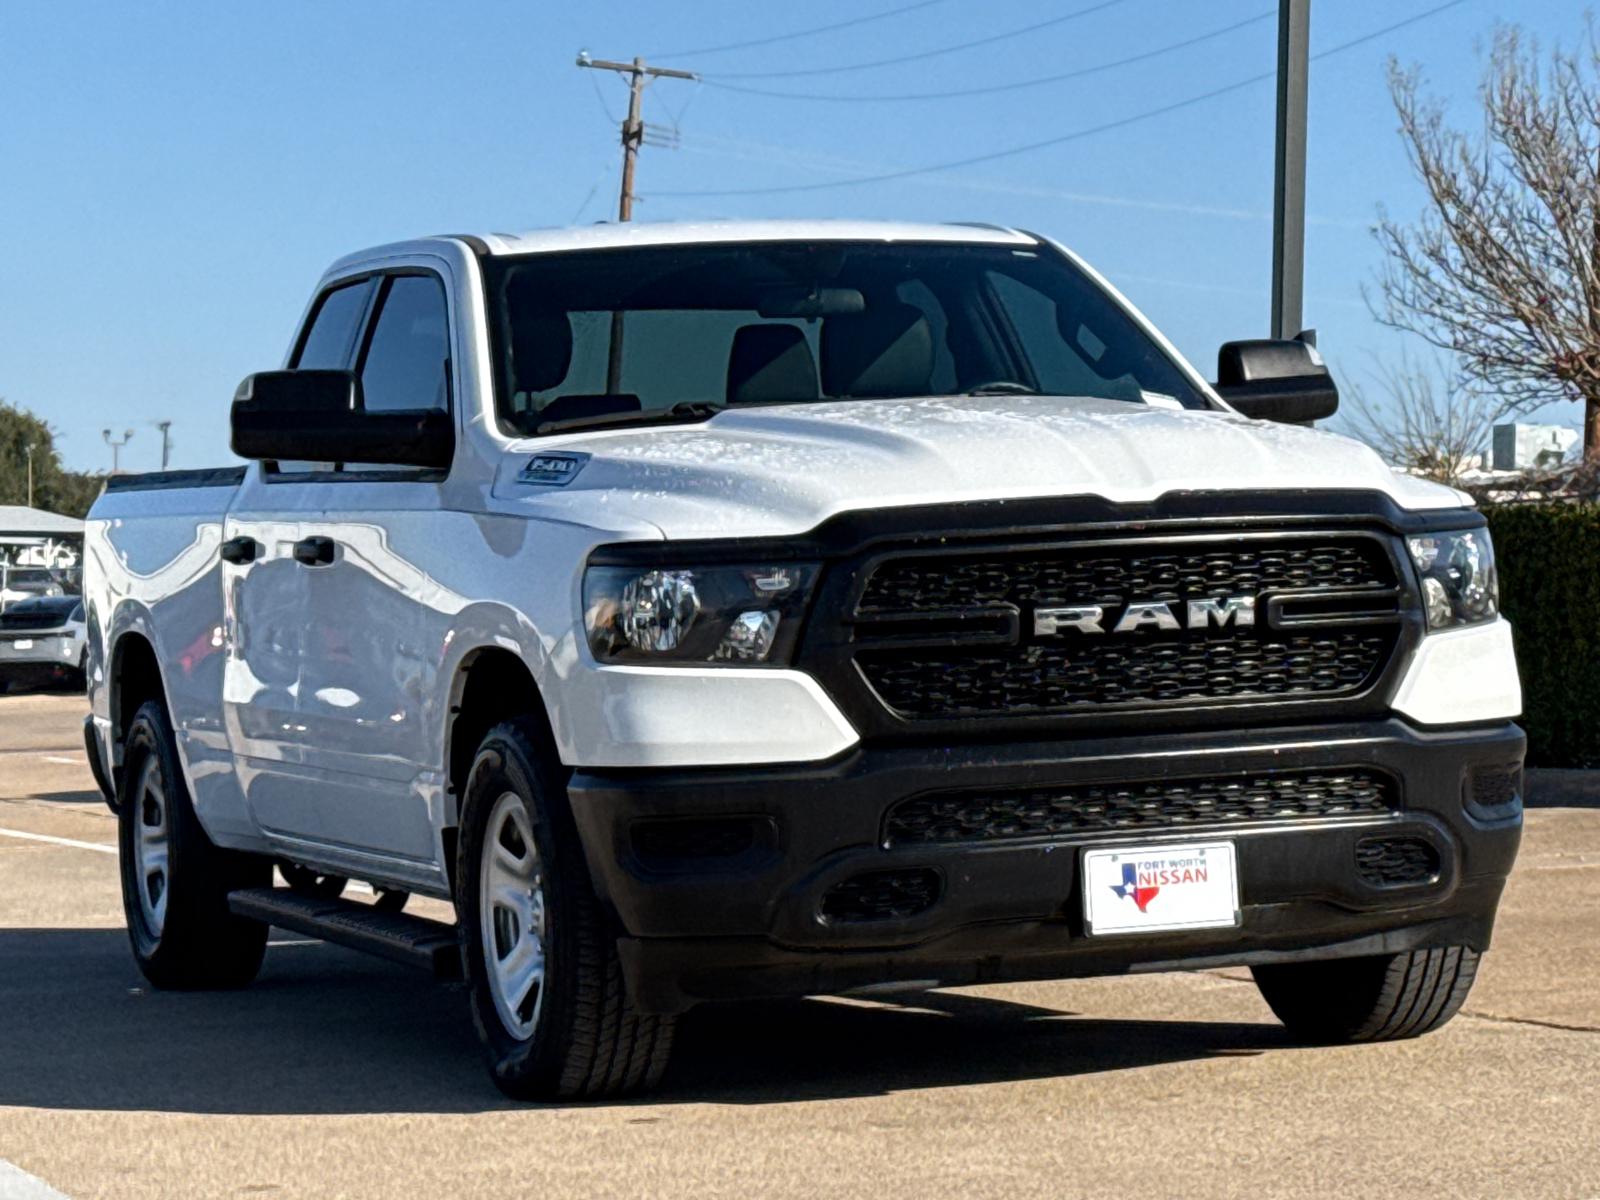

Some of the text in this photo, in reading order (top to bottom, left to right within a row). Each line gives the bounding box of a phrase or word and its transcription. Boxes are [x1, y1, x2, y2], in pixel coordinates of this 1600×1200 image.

[1033, 596, 1255, 636] RAM
[1137, 858, 1207, 870] FORT WORTH
[1138, 868, 1208, 886] NISSAN
